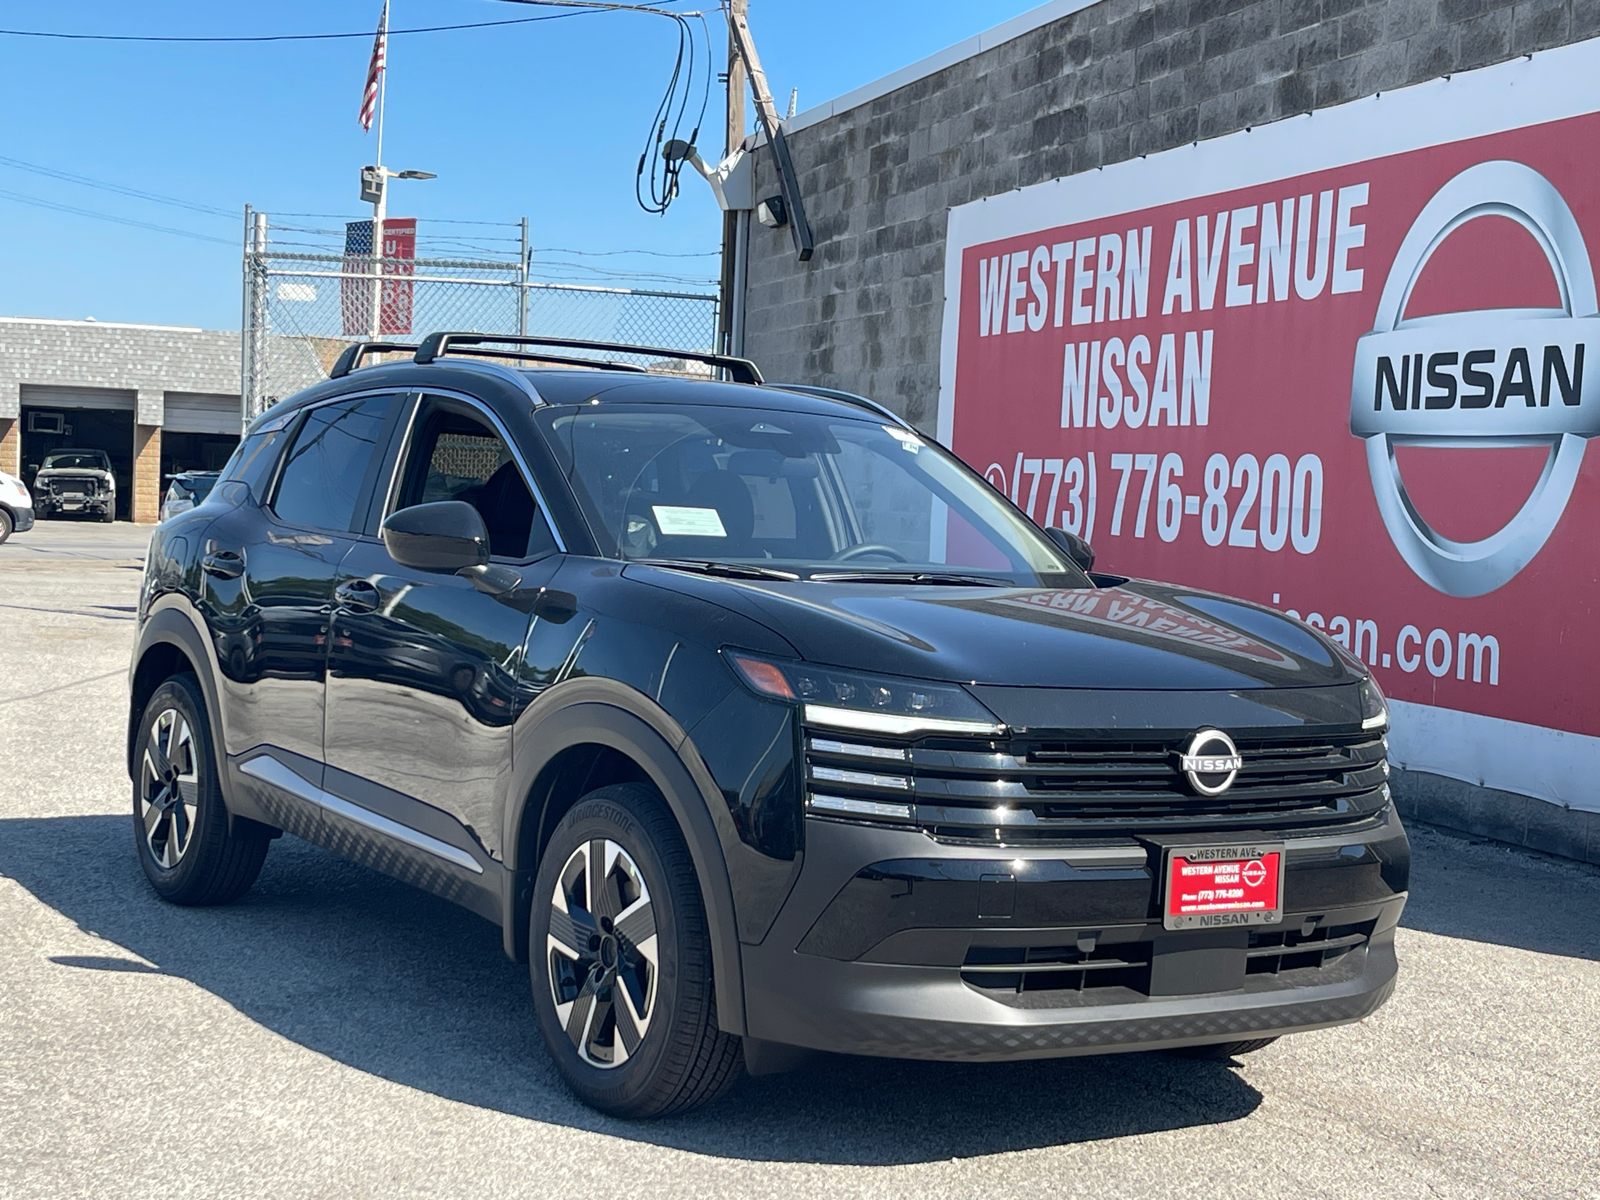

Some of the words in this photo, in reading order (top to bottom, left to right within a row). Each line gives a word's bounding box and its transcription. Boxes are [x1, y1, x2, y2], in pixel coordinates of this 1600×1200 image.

[979, 226, 1153, 337] WESTERN
[1161, 182, 1370, 315] AVENUE
[1061, 330, 1214, 430] NISSAN
[1374, 343, 1586, 412] NISSAN
[1010, 451, 1096, 546] (773)
[1110, 453, 1324, 555] 776-8200
[1183, 757, 1242, 770] NISSAN
[568, 803, 635, 836] BRIDGESTONE
[1196, 848, 1238, 860] WESTERN
[1181, 865, 1214, 876] WESTERN
[1214, 864, 1240, 874] AVENUE
[1214, 874, 1240, 884] NISSAN
[1198, 890, 1214, 902] (773)
[1200, 914, 1249, 926] NISSAN
